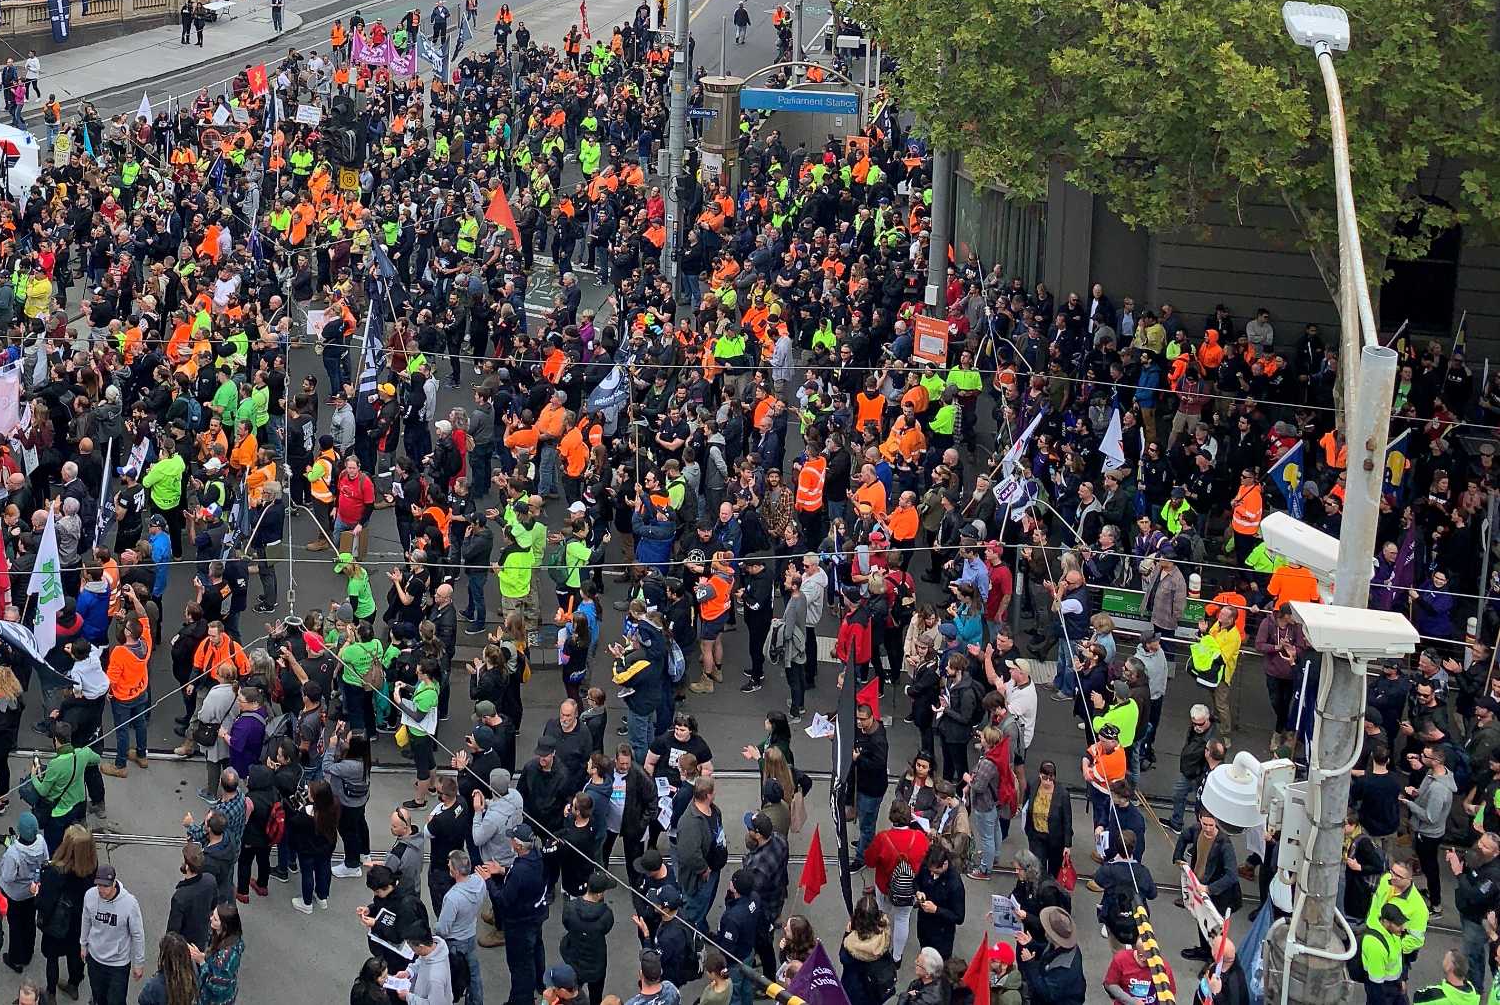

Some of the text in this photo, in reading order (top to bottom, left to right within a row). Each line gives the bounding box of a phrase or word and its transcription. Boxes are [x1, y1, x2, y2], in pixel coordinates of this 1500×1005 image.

[778, 95, 857, 109] Parliament Station
[815, 976, 839, 988] Union
